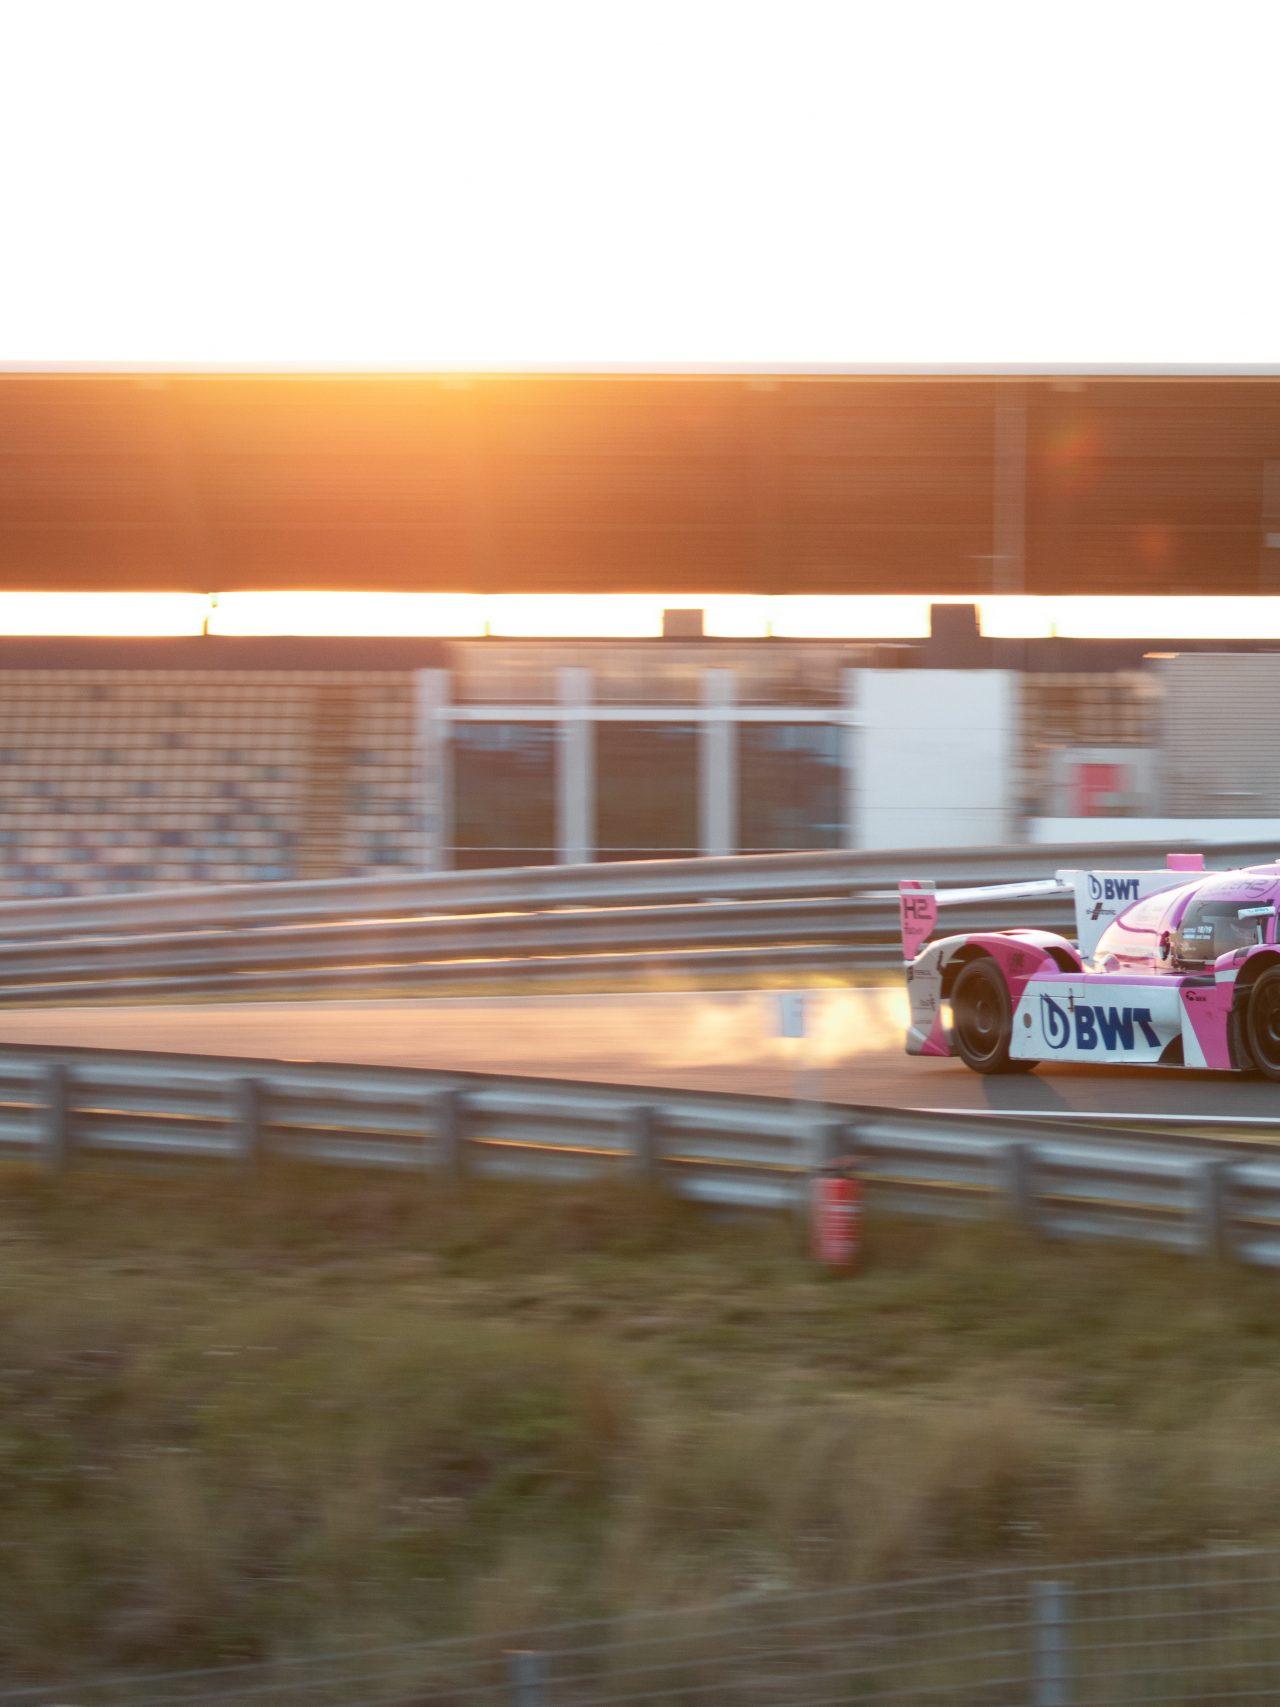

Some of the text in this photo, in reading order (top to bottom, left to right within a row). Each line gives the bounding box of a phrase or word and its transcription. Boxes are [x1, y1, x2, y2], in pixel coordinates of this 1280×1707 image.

[1104, 879, 1139, 900] BWT
[903, 898, 932, 920] H2
[1074, 1005, 1162, 1050] BWT
